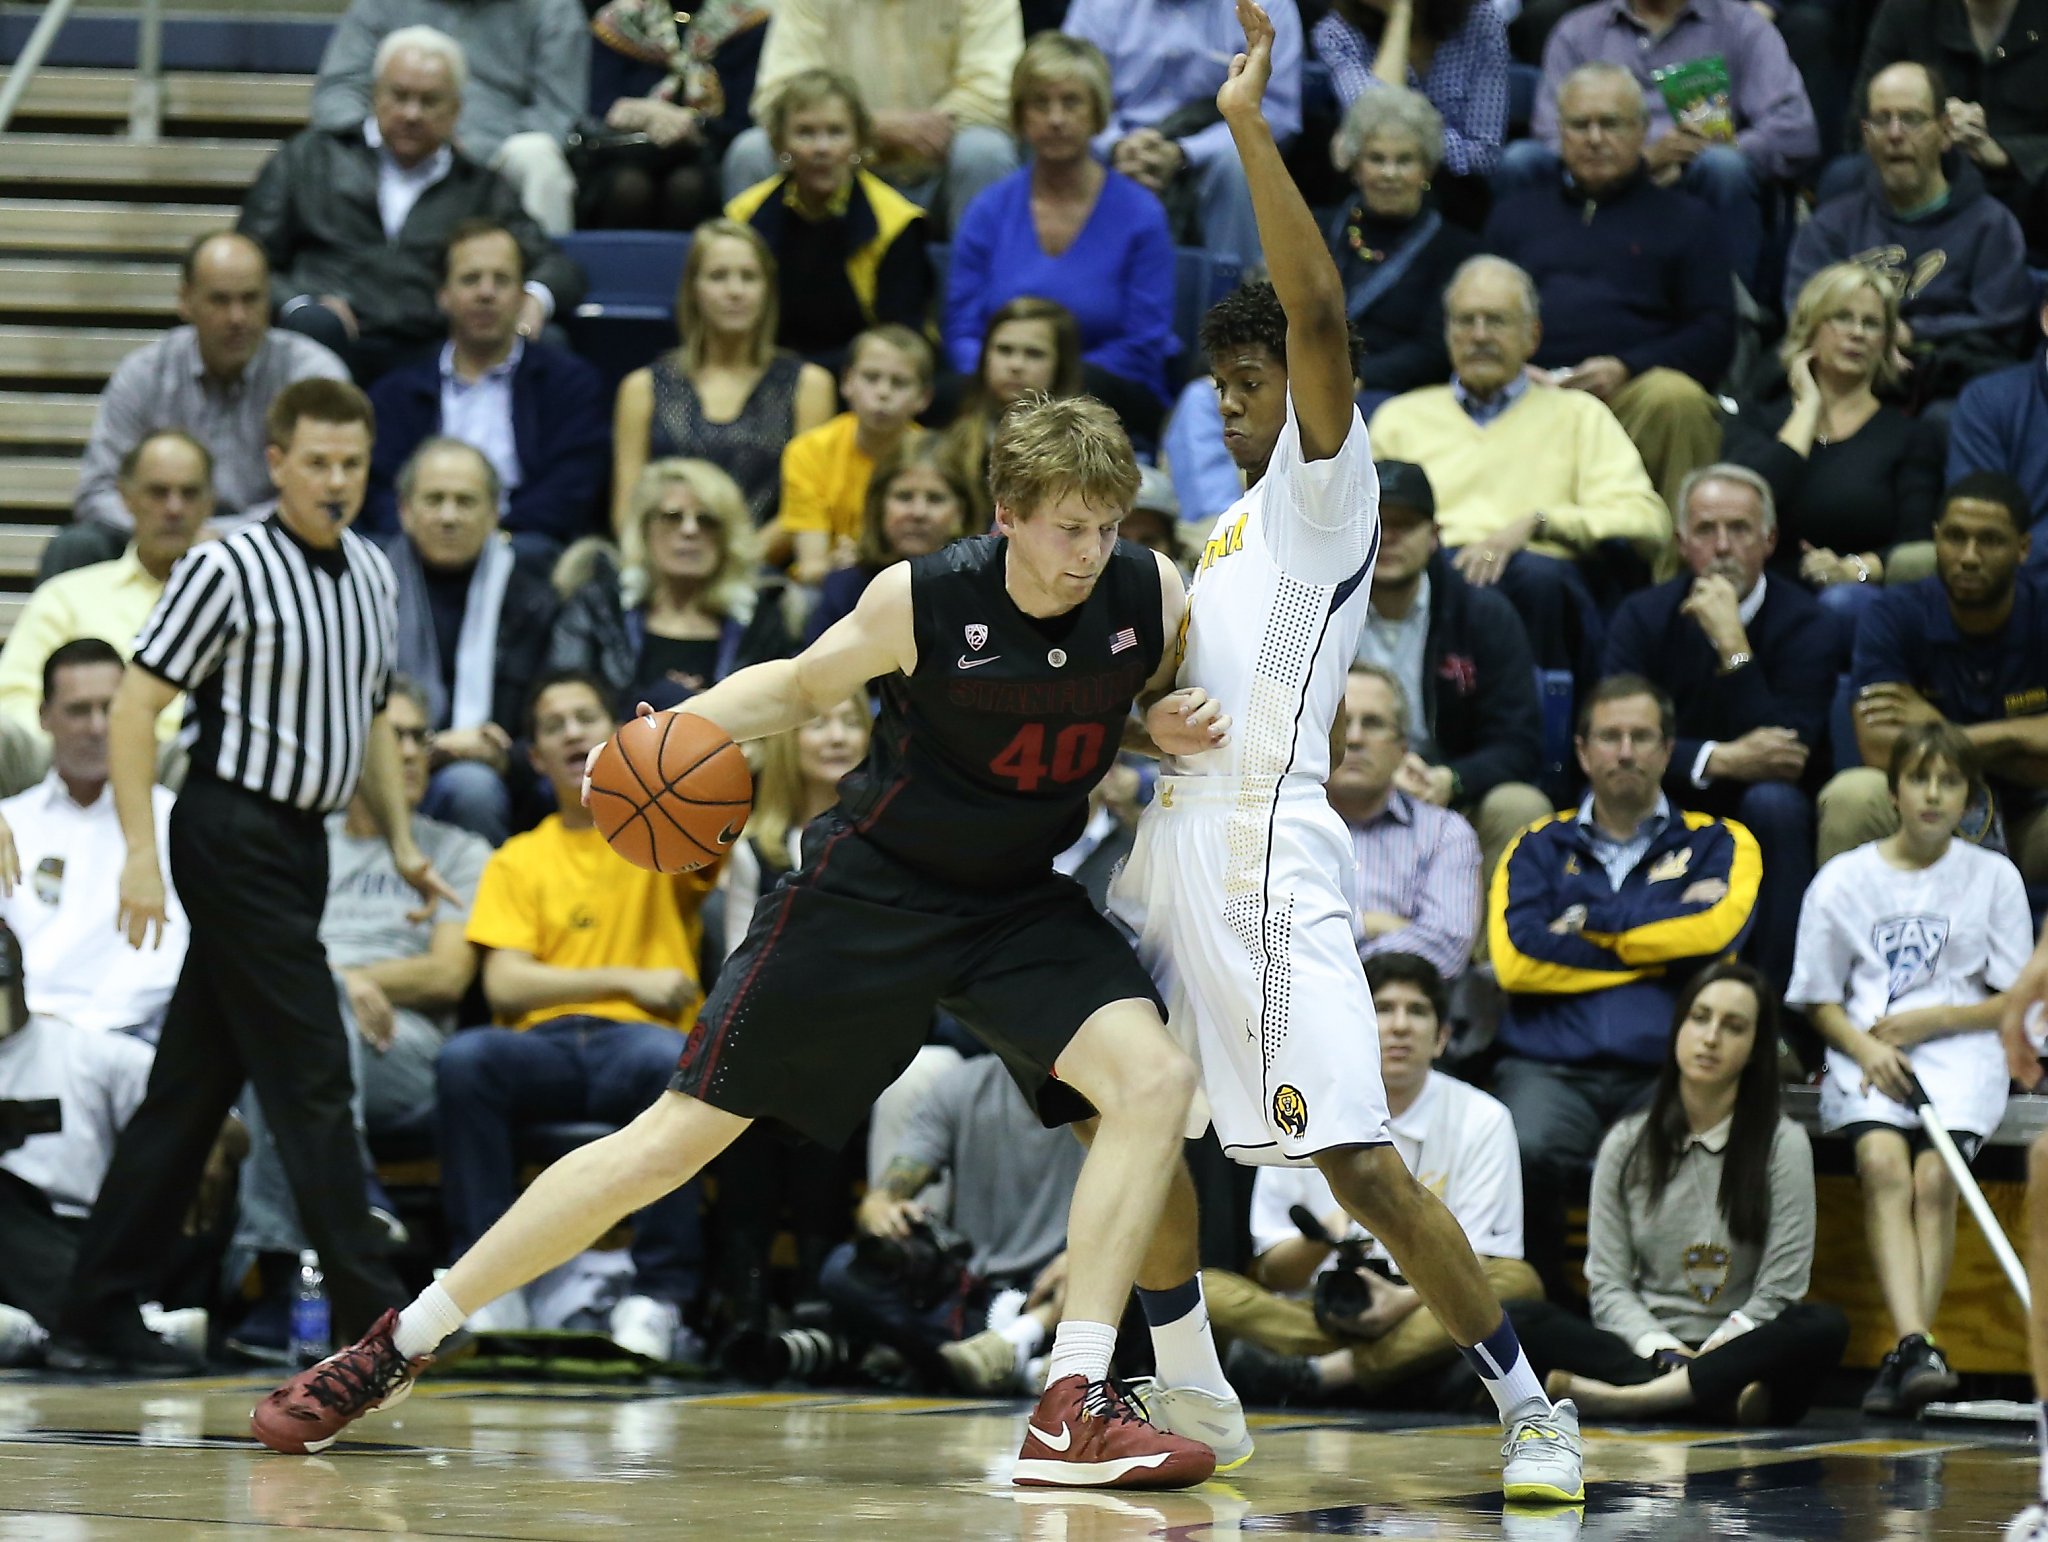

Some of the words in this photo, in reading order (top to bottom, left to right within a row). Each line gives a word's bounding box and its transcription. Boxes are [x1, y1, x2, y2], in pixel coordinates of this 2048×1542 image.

[971, 634, 982, 645] 12
[989, 722, 1105, 791] 40
[1876, 919, 1944, 968] PAC
